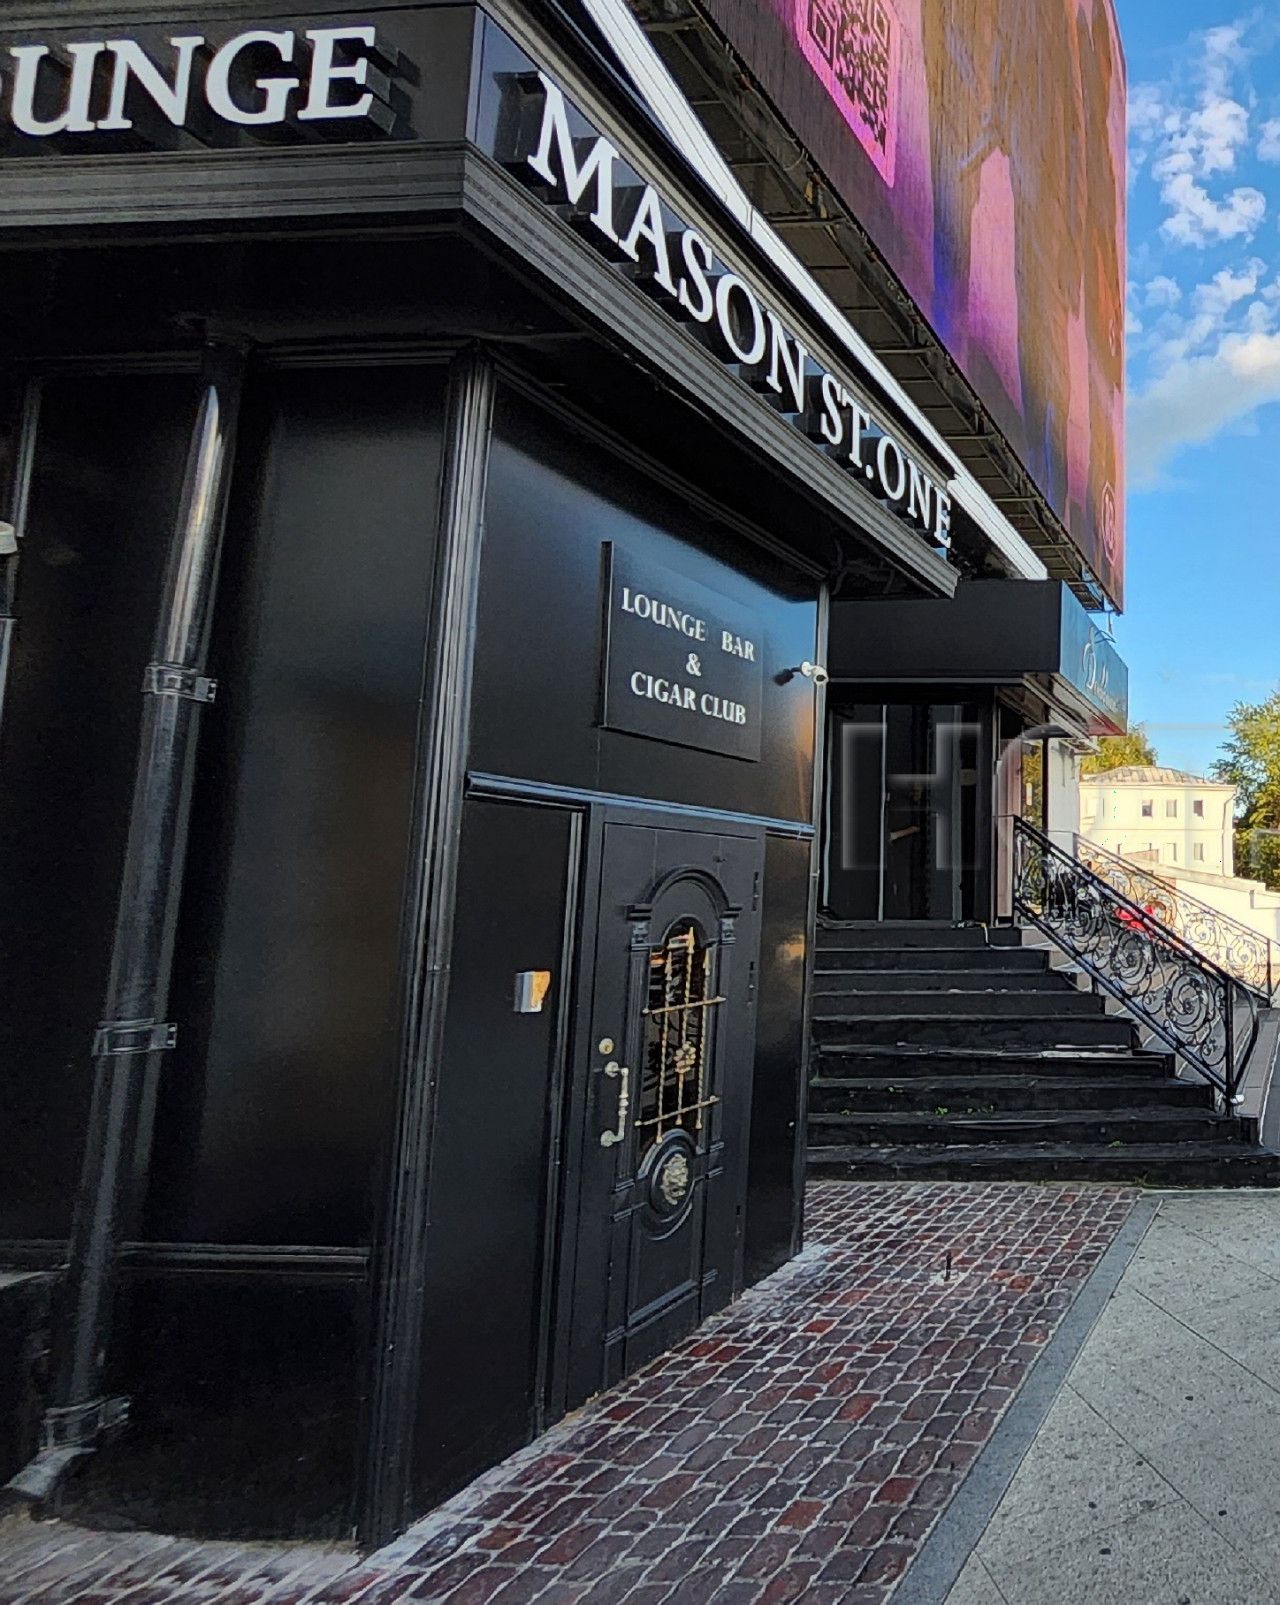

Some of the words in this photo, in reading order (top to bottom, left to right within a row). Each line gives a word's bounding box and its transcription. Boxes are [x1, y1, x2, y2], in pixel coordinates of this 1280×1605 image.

[0, 26, 376, 136] UNGE
[526, 70, 808, 414] MASON
[820, 373, 954, 548] ST.ONE
[620, 587, 707, 642] LOUNGE
[720, 630, 756, 662] BAR
[630, 671, 698, 712] CIGAR
[700, 693, 747, 725] CLUB
[685, 652, 702, 677] &
